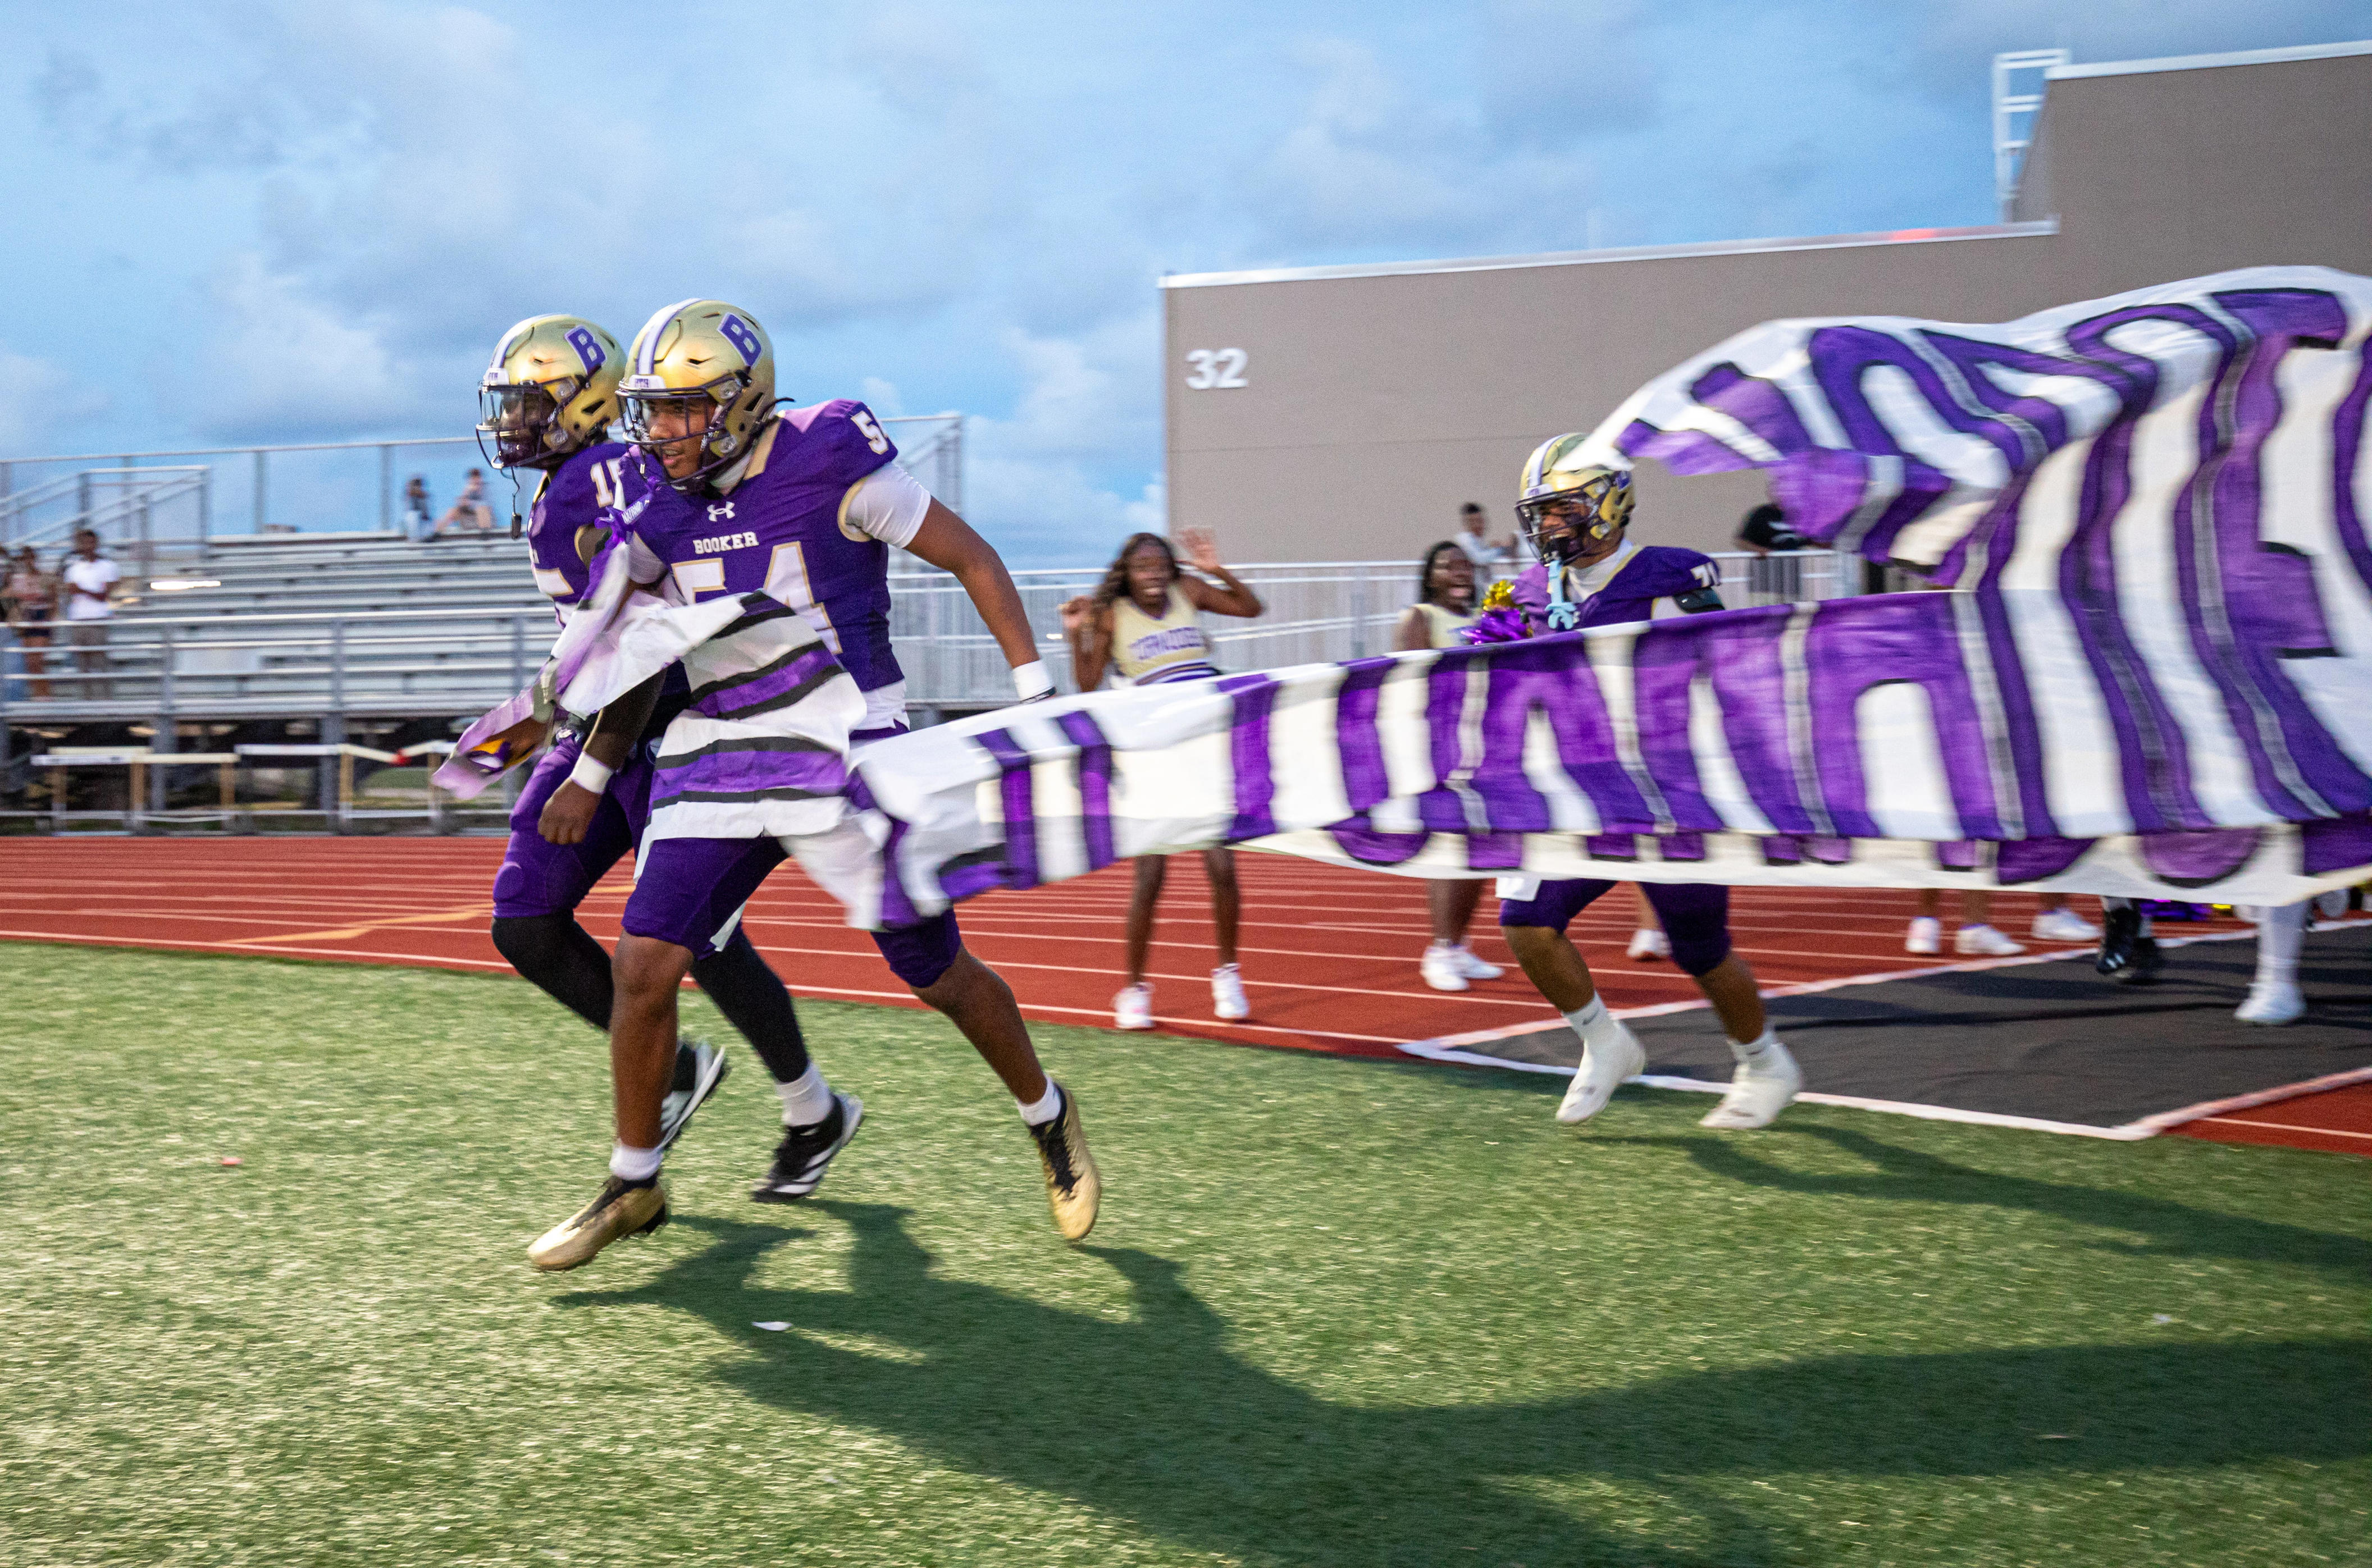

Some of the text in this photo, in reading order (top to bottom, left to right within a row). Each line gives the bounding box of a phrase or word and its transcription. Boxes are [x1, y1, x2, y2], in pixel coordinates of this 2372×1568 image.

[564, 324, 607, 376] B
[717, 312, 762, 368] B
[1185, 348, 1248, 390] 32
[850, 406, 892, 455] 5
[692, 531, 759, 554] BOOKER
